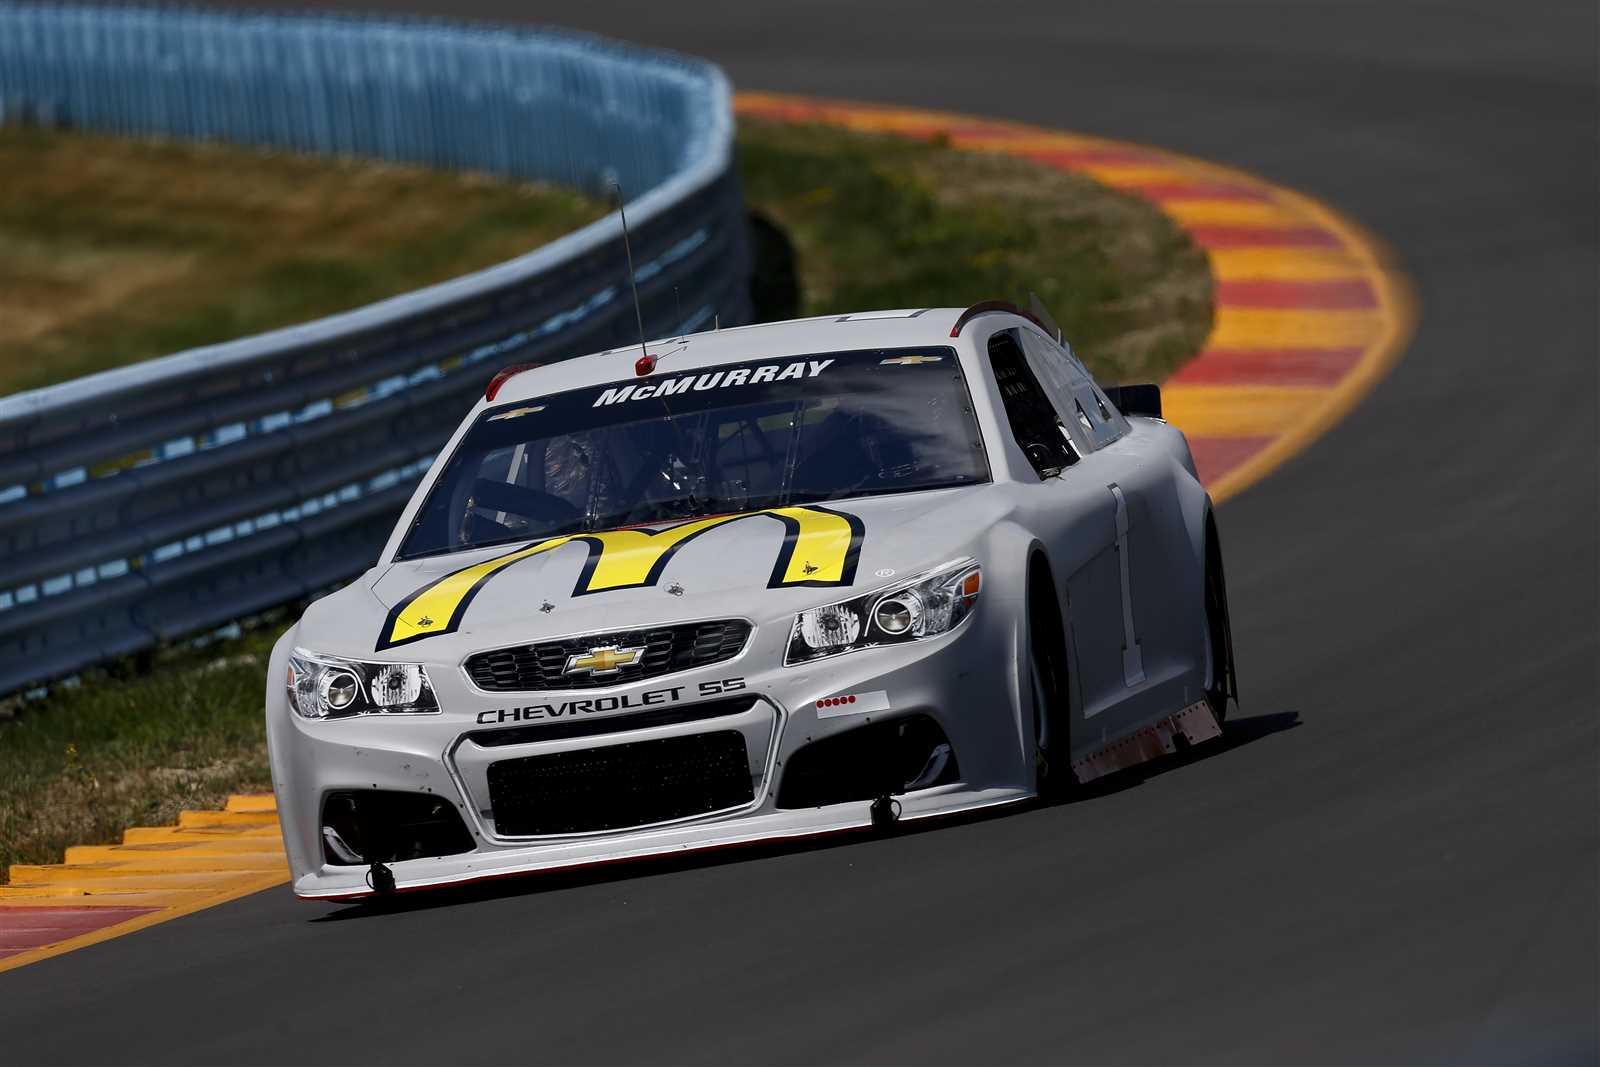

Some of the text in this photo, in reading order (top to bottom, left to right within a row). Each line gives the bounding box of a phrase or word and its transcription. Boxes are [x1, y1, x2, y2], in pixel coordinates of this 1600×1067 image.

[592, 359, 835, 408] McMURRAY
[476, 677, 747, 725] CHEVROLET SS
